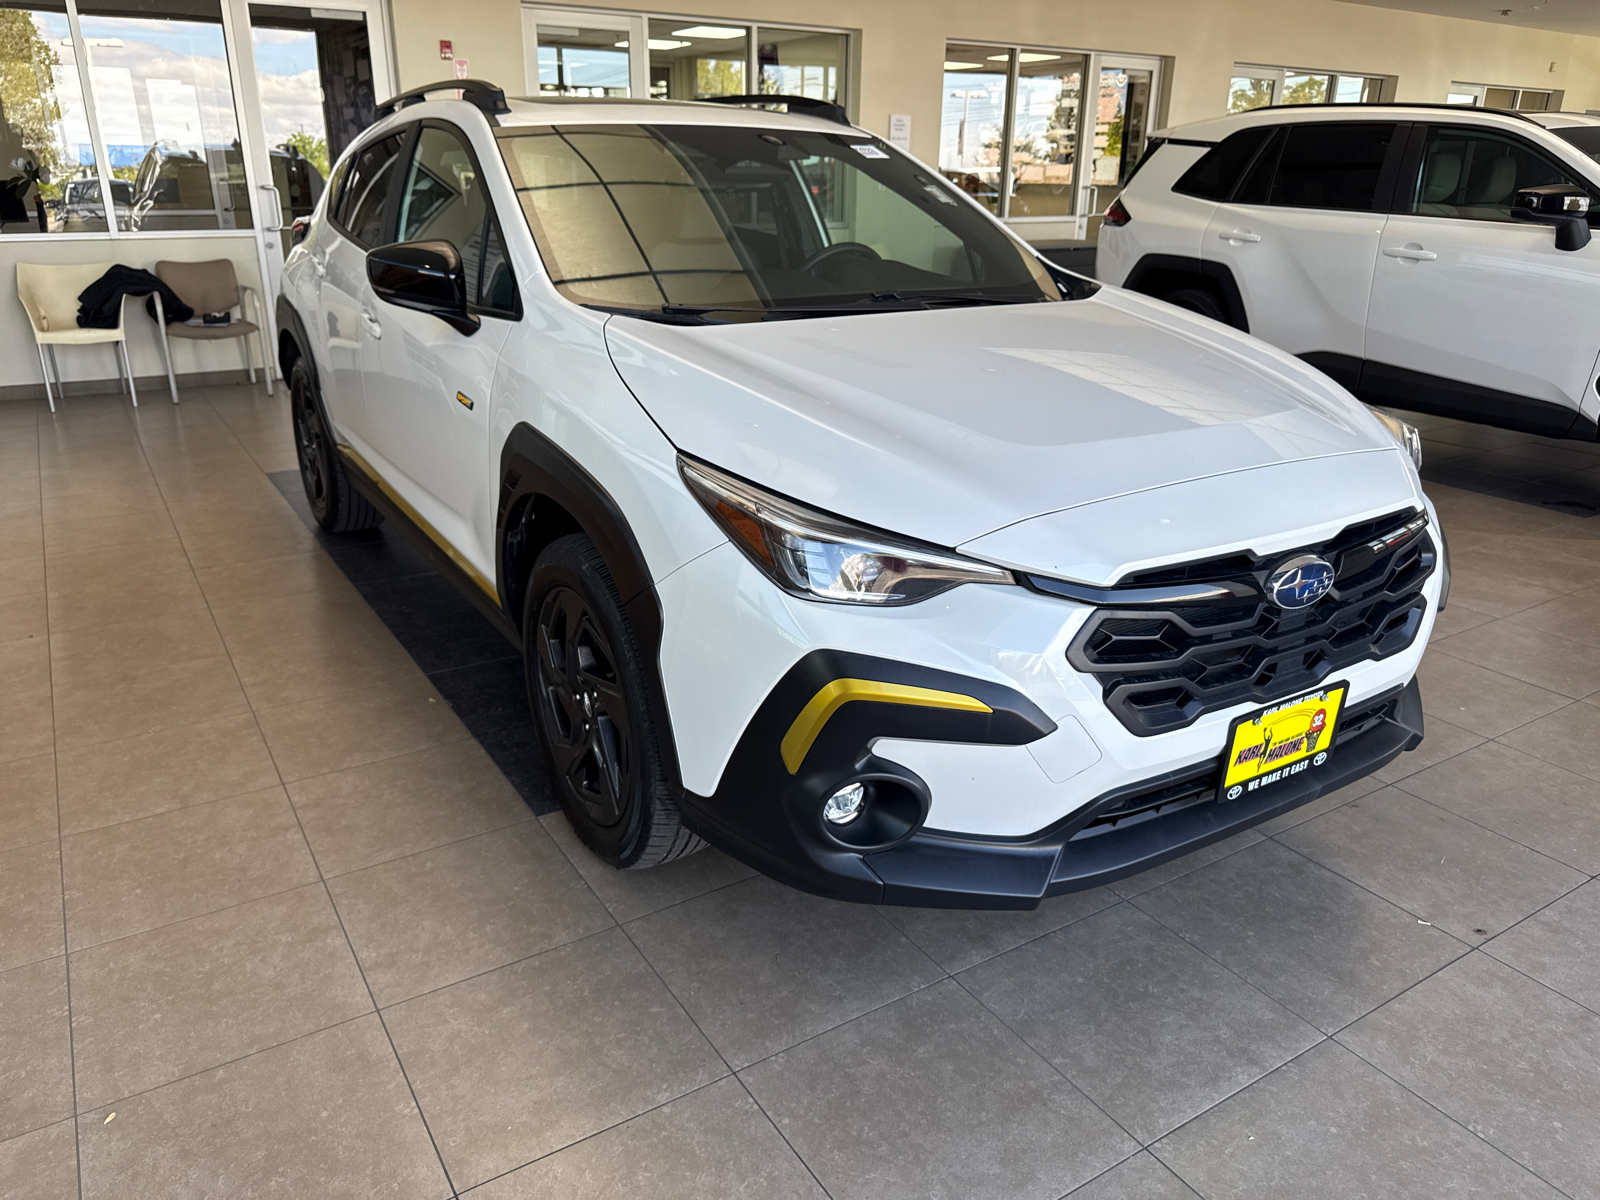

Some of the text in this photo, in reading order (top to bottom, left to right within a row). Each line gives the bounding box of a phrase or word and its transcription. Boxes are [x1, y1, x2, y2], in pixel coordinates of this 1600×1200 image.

[1262, 706, 1279, 717] KARL
[1279, 697, 1304, 711] MALONE
[1312, 714, 1324, 727] 32
[1233, 742, 1264, 767] KARL
[1263, 736, 1306, 765] MALONE
[1248, 759, 1309, 792] WE MAKE IT EASY
